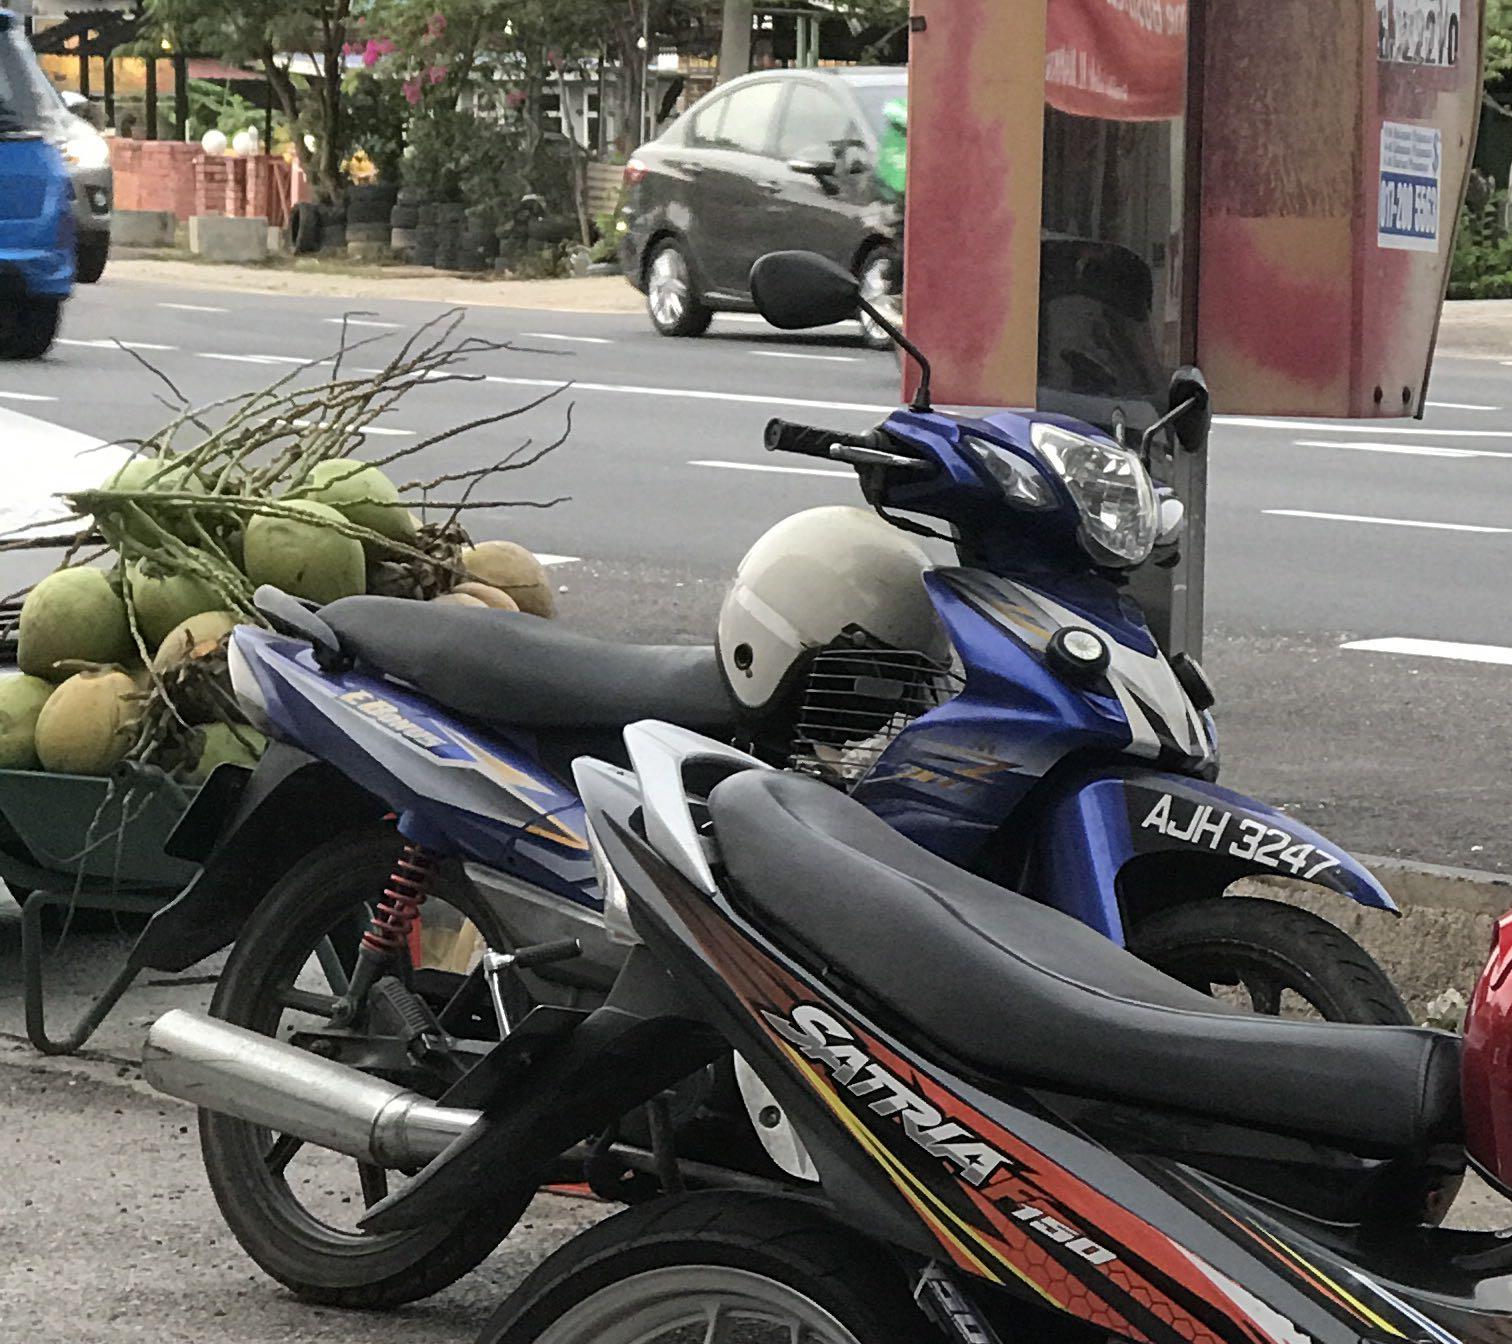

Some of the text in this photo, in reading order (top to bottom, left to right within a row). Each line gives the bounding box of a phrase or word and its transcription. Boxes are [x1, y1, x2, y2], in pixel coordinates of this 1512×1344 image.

[1141, 794, 1341, 880] AJH 3247
[760, 1005, 1016, 1187] SATRIA
